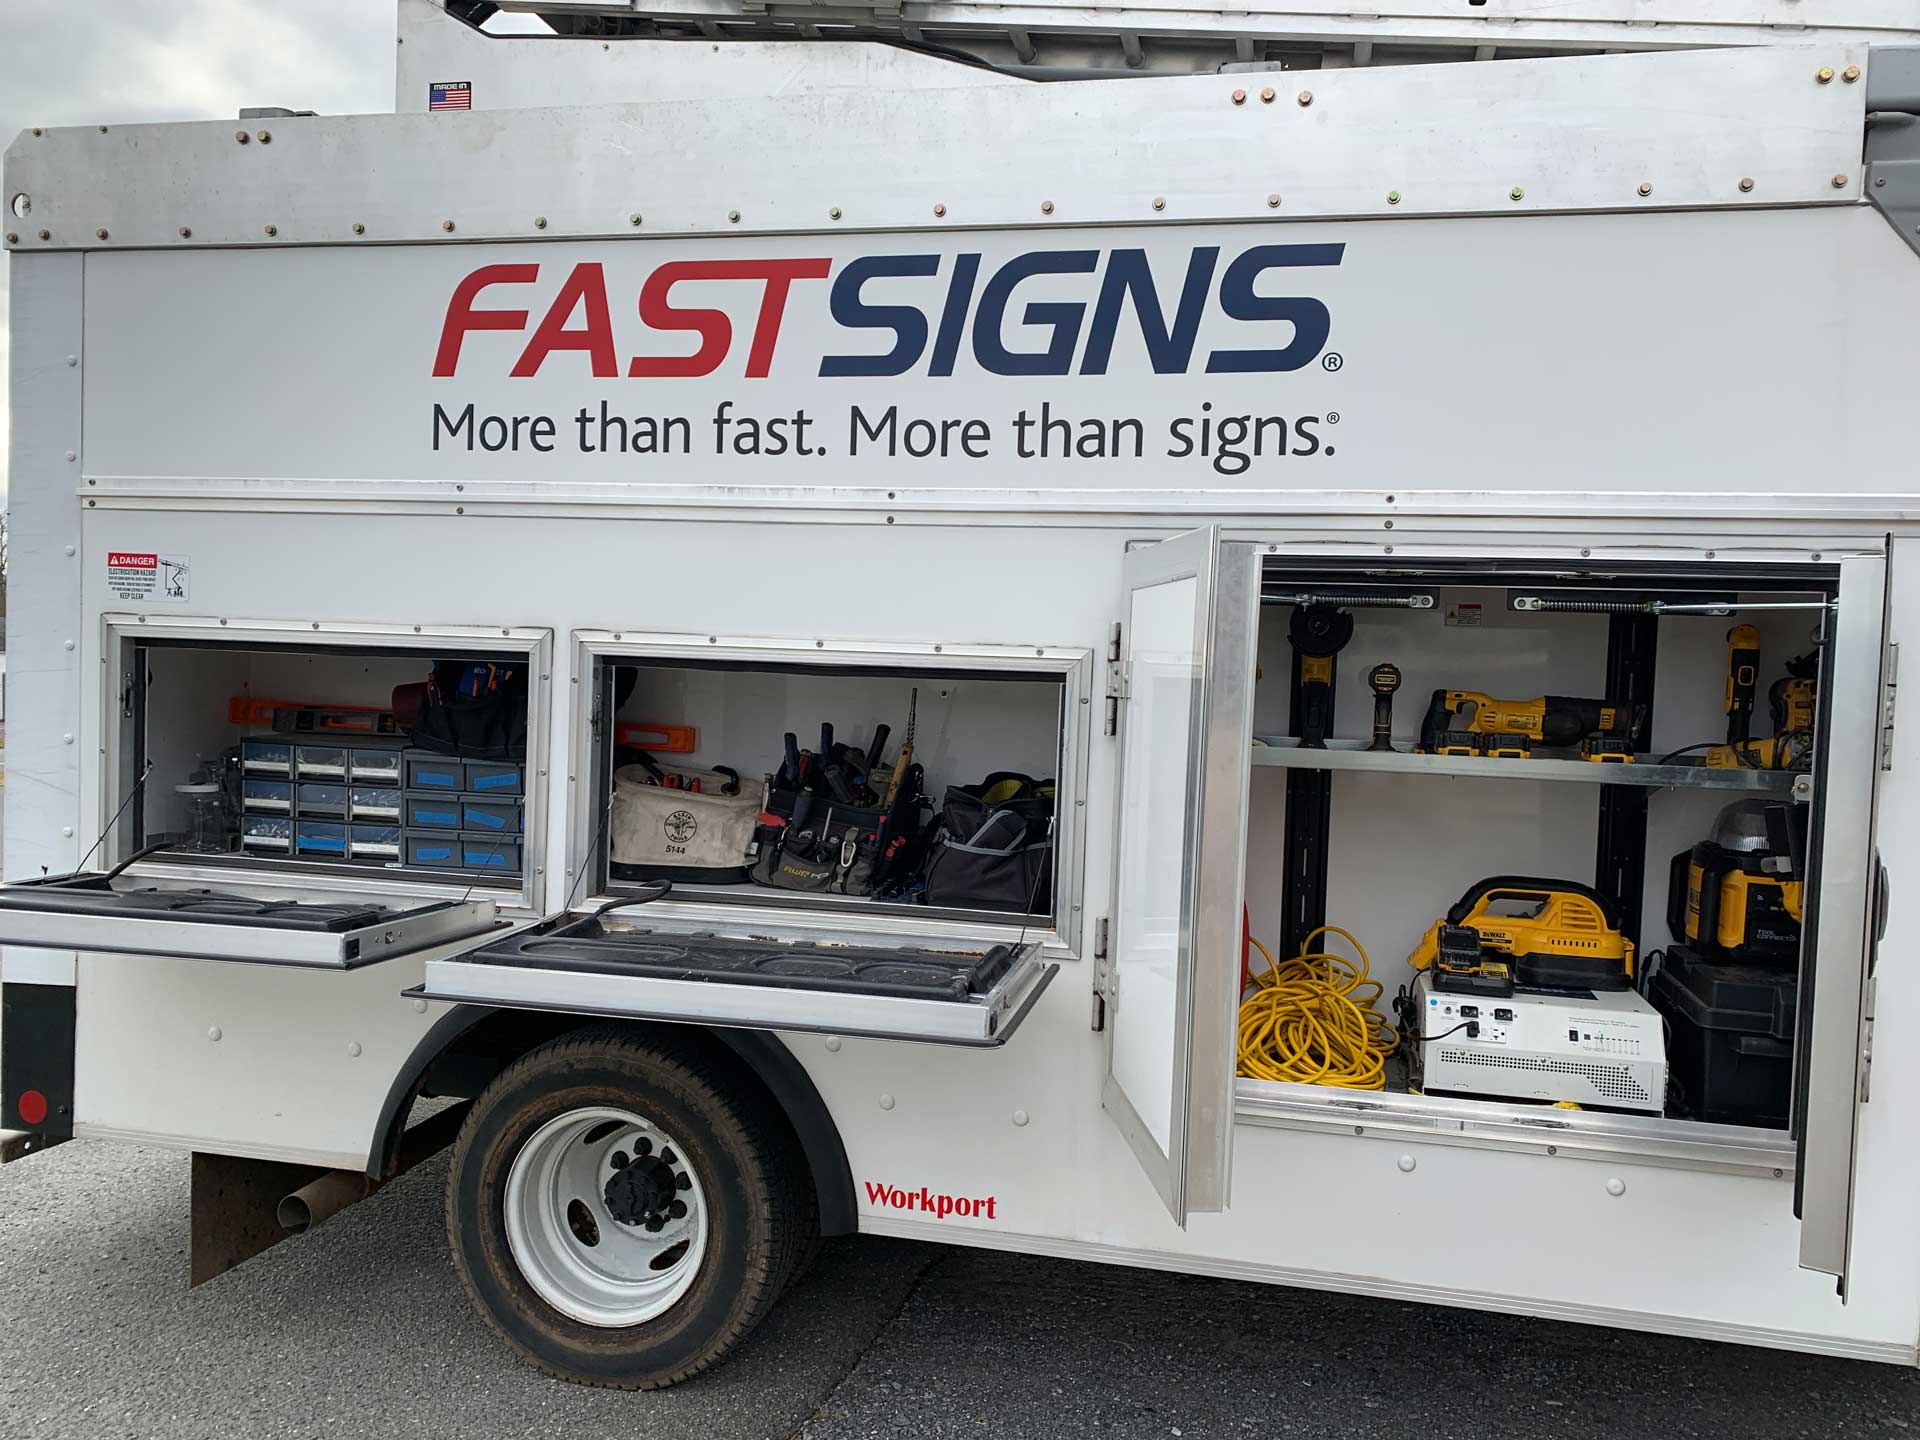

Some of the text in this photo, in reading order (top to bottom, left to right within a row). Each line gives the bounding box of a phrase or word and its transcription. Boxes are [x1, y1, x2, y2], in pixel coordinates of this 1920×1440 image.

[433, 403, 556, 453] More
[574, 399, 691, 454] than
[712, 400, 827, 457] fast.
[849, 405, 991, 459] More
[1012, 401, 1144, 459] than
[119, 556, 155, 566] DANGER
[119, 592, 130, 600] KEEP
[665, 844, 686, 855] 5144
[864, 1181, 997, 1220] Workport
